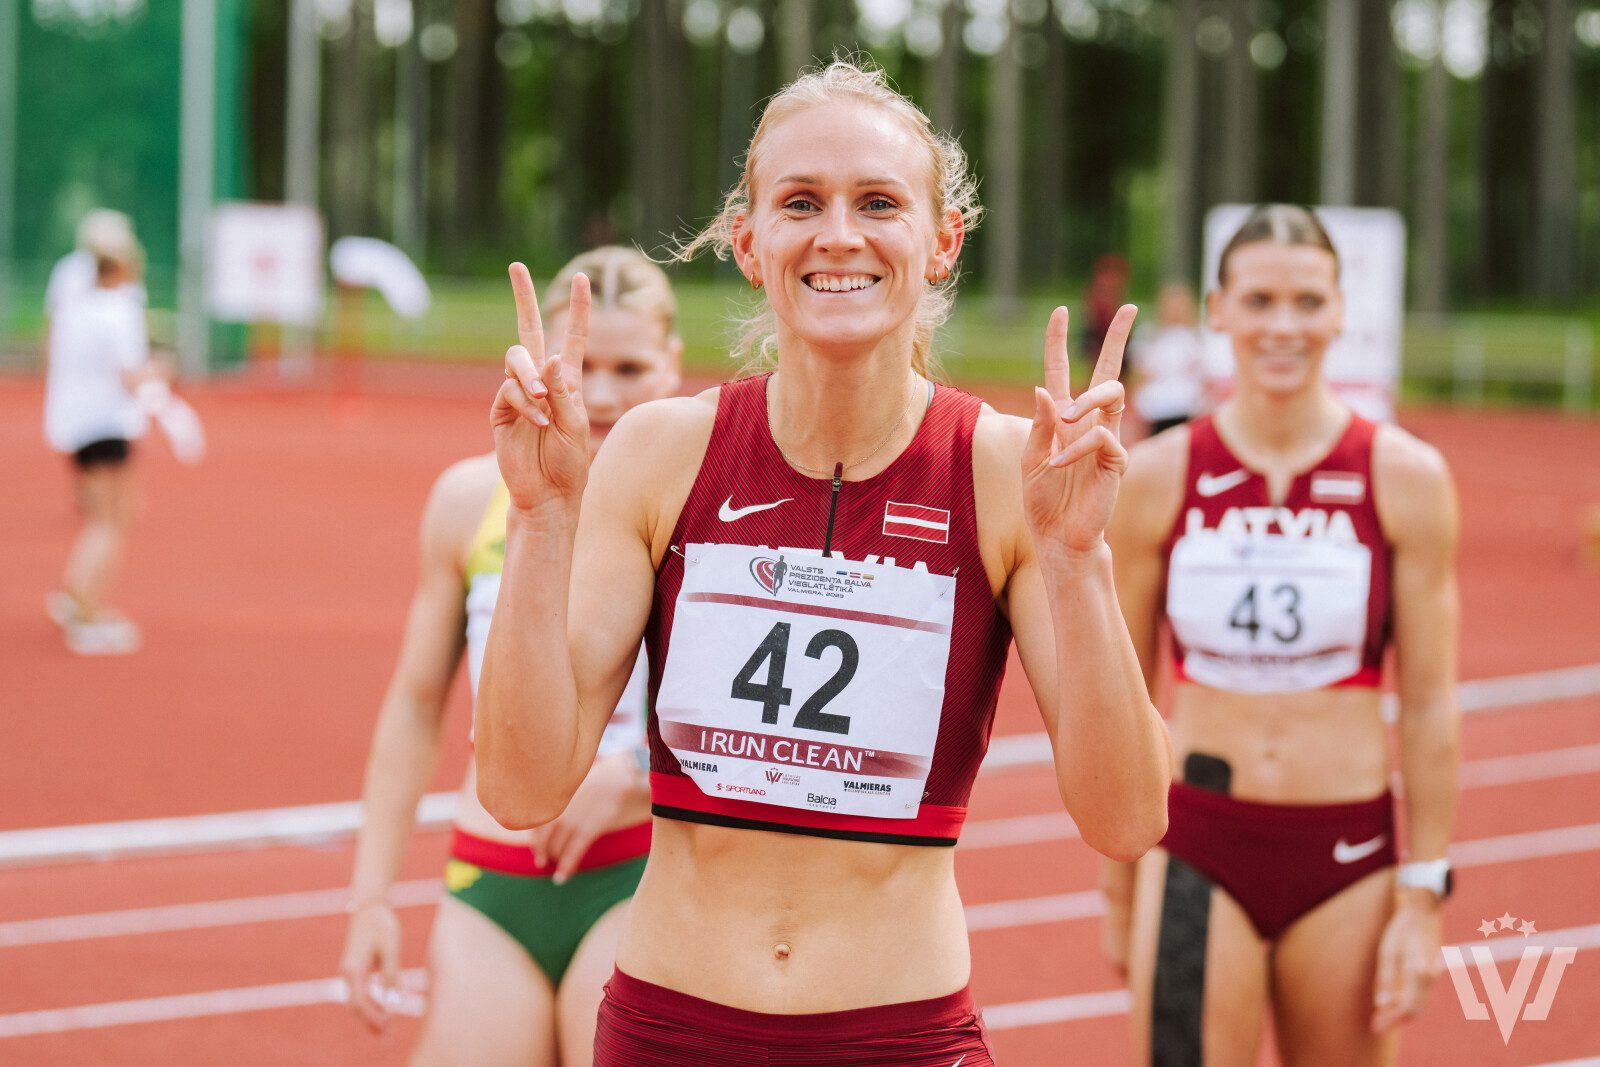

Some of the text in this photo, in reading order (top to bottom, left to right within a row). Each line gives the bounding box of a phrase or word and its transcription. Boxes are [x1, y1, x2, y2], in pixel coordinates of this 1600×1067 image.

[1185, 506, 1359, 542] LATVIA
[790, 564, 824, 575] VALSTS
[788, 572, 872, 589] PREZIDENTA BALVA
[825, 591, 845, 599] 2023
[1228, 583, 1303, 644] 43
[731, 621, 859, 735] 42
[700, 730, 707, 751] I
[711, 731, 766, 759] RUN
[679, 759, 719, 774] VALMIERA
[843, 780, 892, 793] VALMIERAS
[806, 792, 837, 806] Balcia
